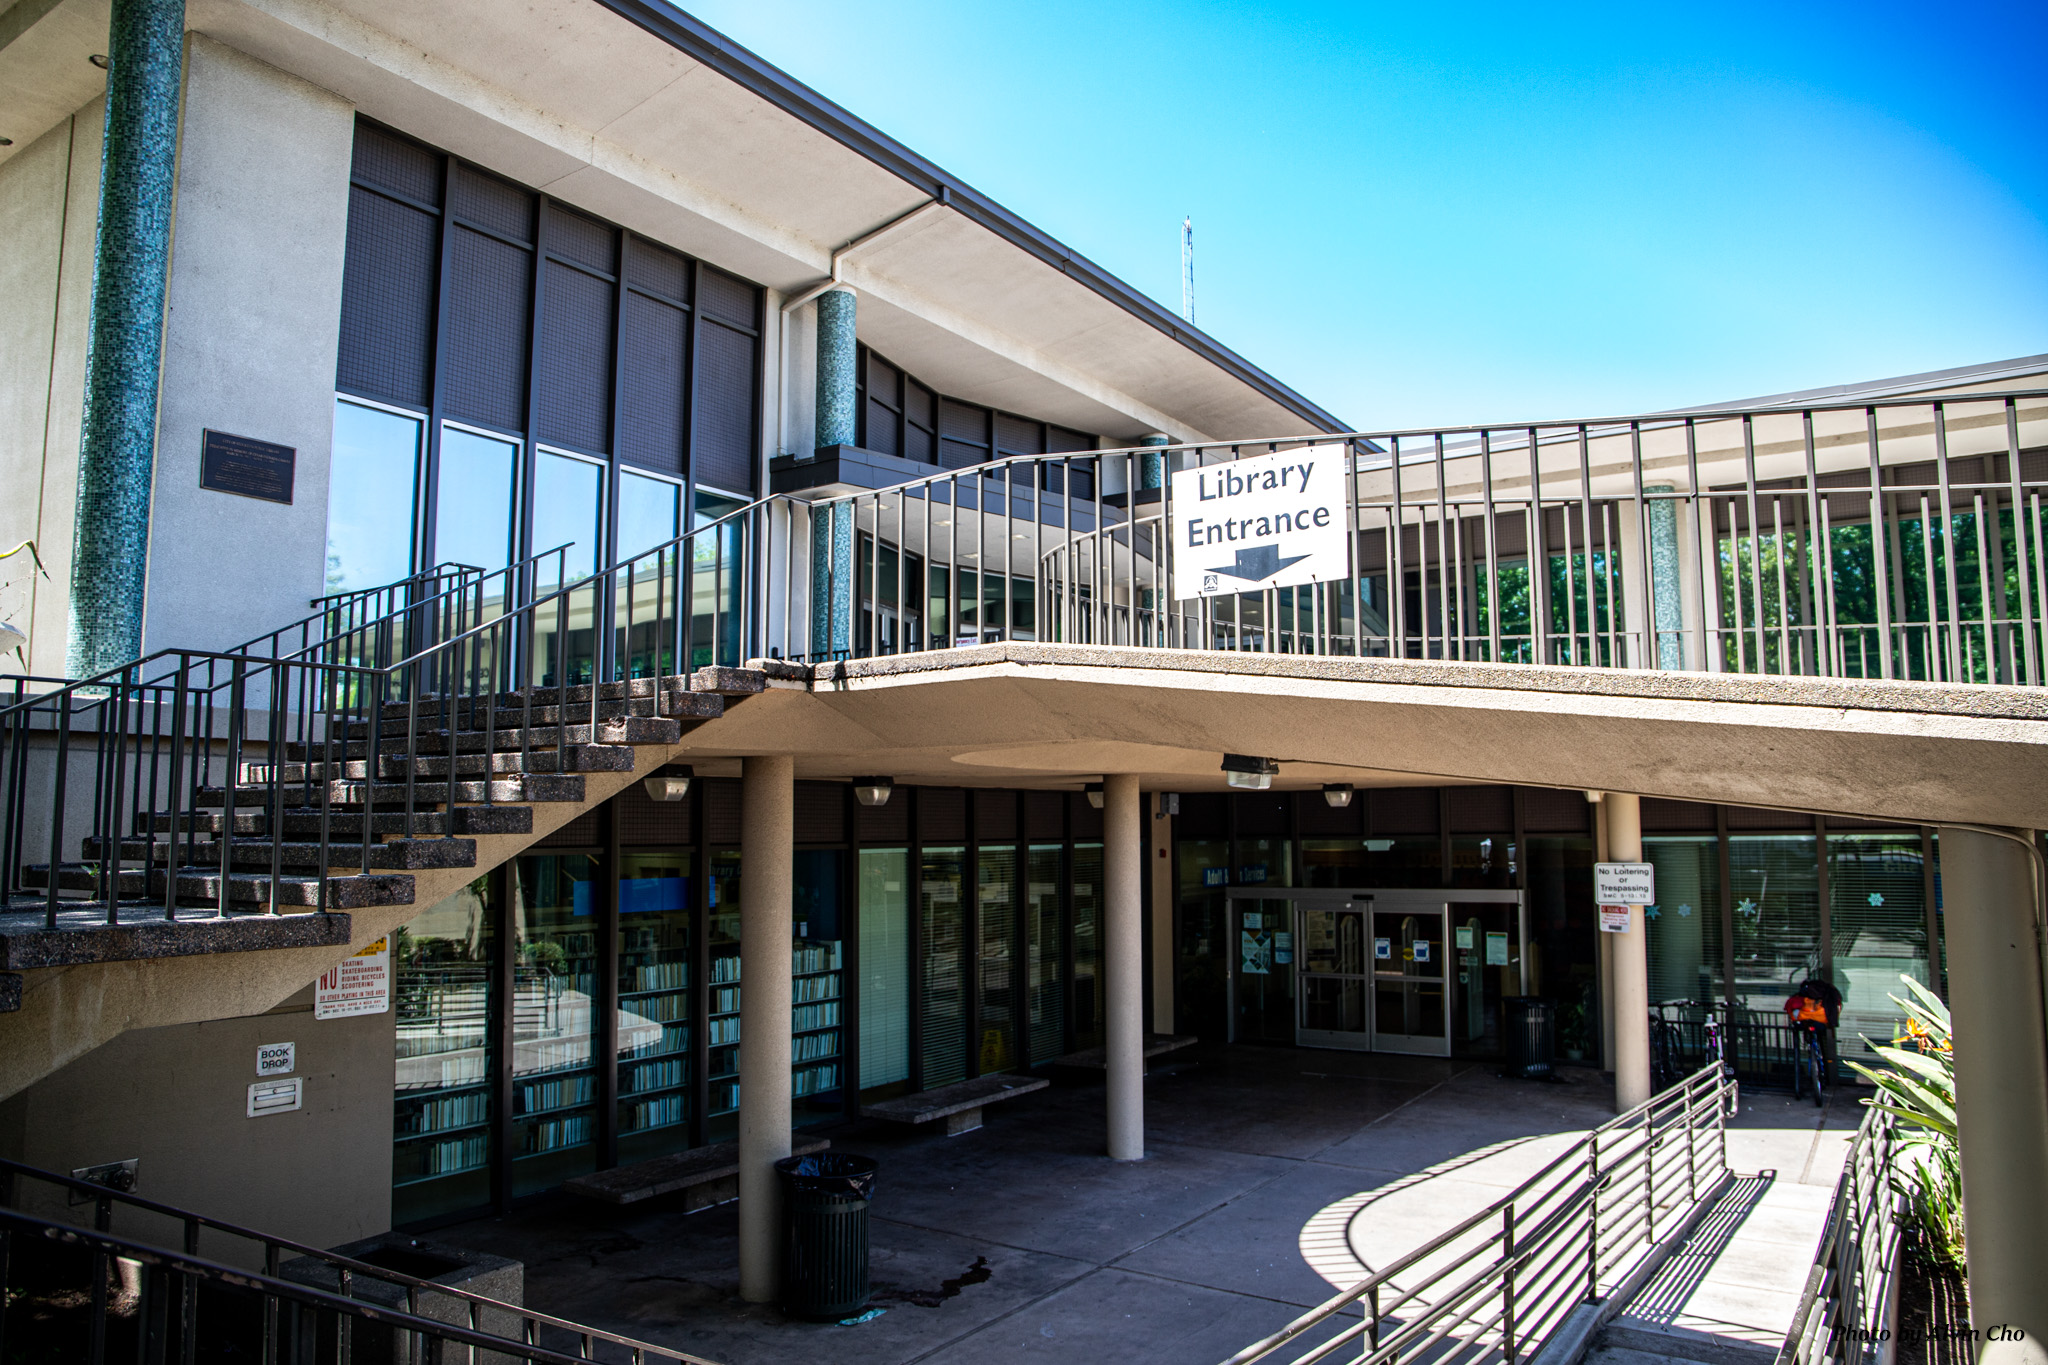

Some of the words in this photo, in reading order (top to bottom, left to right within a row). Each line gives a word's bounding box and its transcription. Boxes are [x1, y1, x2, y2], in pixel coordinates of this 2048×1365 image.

[1199, 461, 1314, 502] Library
[1188, 506, 1330, 548] Entrance
[342, 966, 383, 975] SKATEBOARDING
[320, 966, 337, 990] NO
[342, 981, 374, 989] SCOOTERING
[262, 1048, 289, 1058] BOOK
[262, 1059, 288, 1069] DROP
